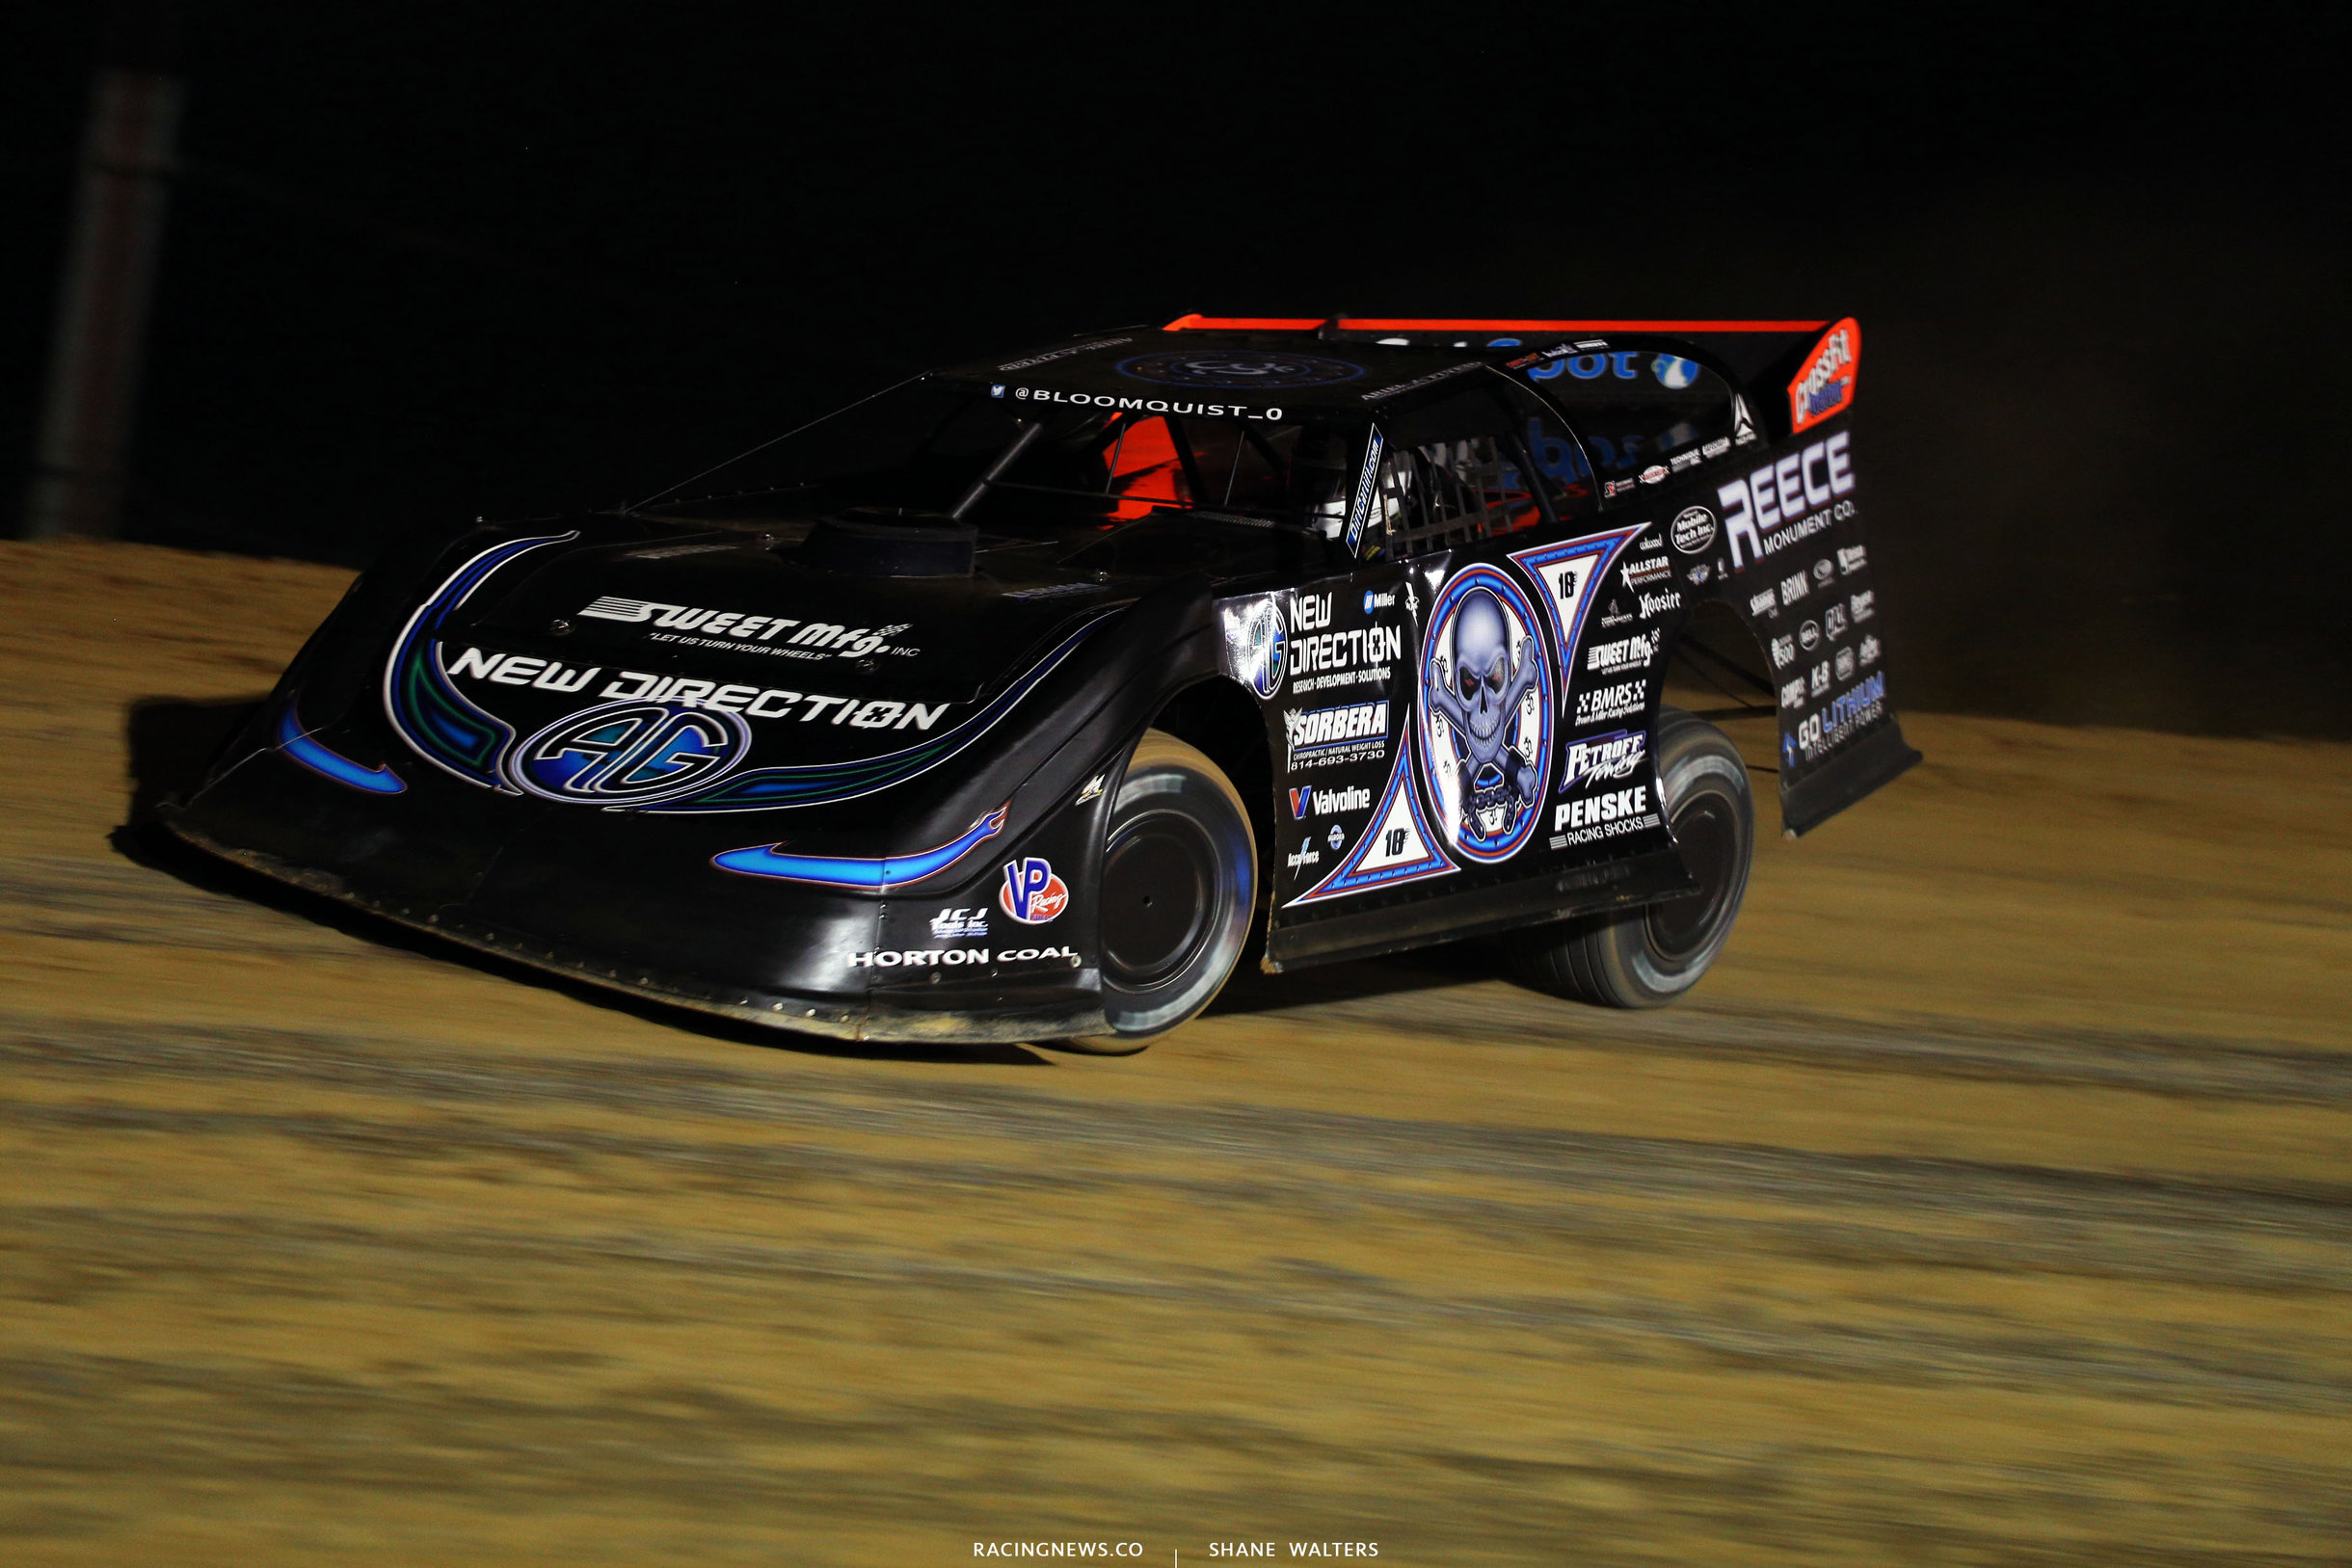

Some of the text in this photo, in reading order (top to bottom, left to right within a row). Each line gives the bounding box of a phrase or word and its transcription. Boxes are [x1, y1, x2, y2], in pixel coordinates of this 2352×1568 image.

[1015, 387, 1283, 421] @BLOOMQUIST_0
[1717, 430, 1856, 573] REECE
[1675, 529, 1697, 545] Tech
[1676, 514, 1708, 533] Mobile
[1763, 508, 1832, 555] MONUMENT
[1629, 555, 1670, 575] ALLSTAR
[1290, 591, 1333, 634] NEW
[1374, 593, 1396, 609] Miller
[1639, 587, 1681, 620] Hoosier
[577, 595, 801, 642] SWEET
[890, 647, 921, 658] INC
[679, 635, 697, 647] US
[698, 638, 735, 651] TURN
[732, 642, 773, 656] YOUR
[1290, 622, 1402, 677] DIRECTION
[1588, 639, 1630, 671] SWEET
[446, 647, 950, 731] NEW DIRECTION
[1590, 681, 1633, 713] BMRS
[1294, 703, 1386, 747] SORBERA
[1798, 712, 1821, 750] GO
[1822, 670, 1885, 732] LITHIUM
[534, 705, 730, 794] AG
[1291, 749, 1385, 770] 814-693-3730
[1372, 740, 1385, 749] LOSS
[1564, 734, 1643, 787] PETROFF
[1582, 749, 1646, 789] Towing
[1312, 785, 1370, 816] Valvoline
[1554, 785, 1646, 832] PENSKE
[1567, 816, 1644, 846] RACING SHOCKS
[1002, 857, 1053, 921] VP
[1031, 892, 1067, 913] Racing
[848, 945, 1079, 970] HORTON COAL
